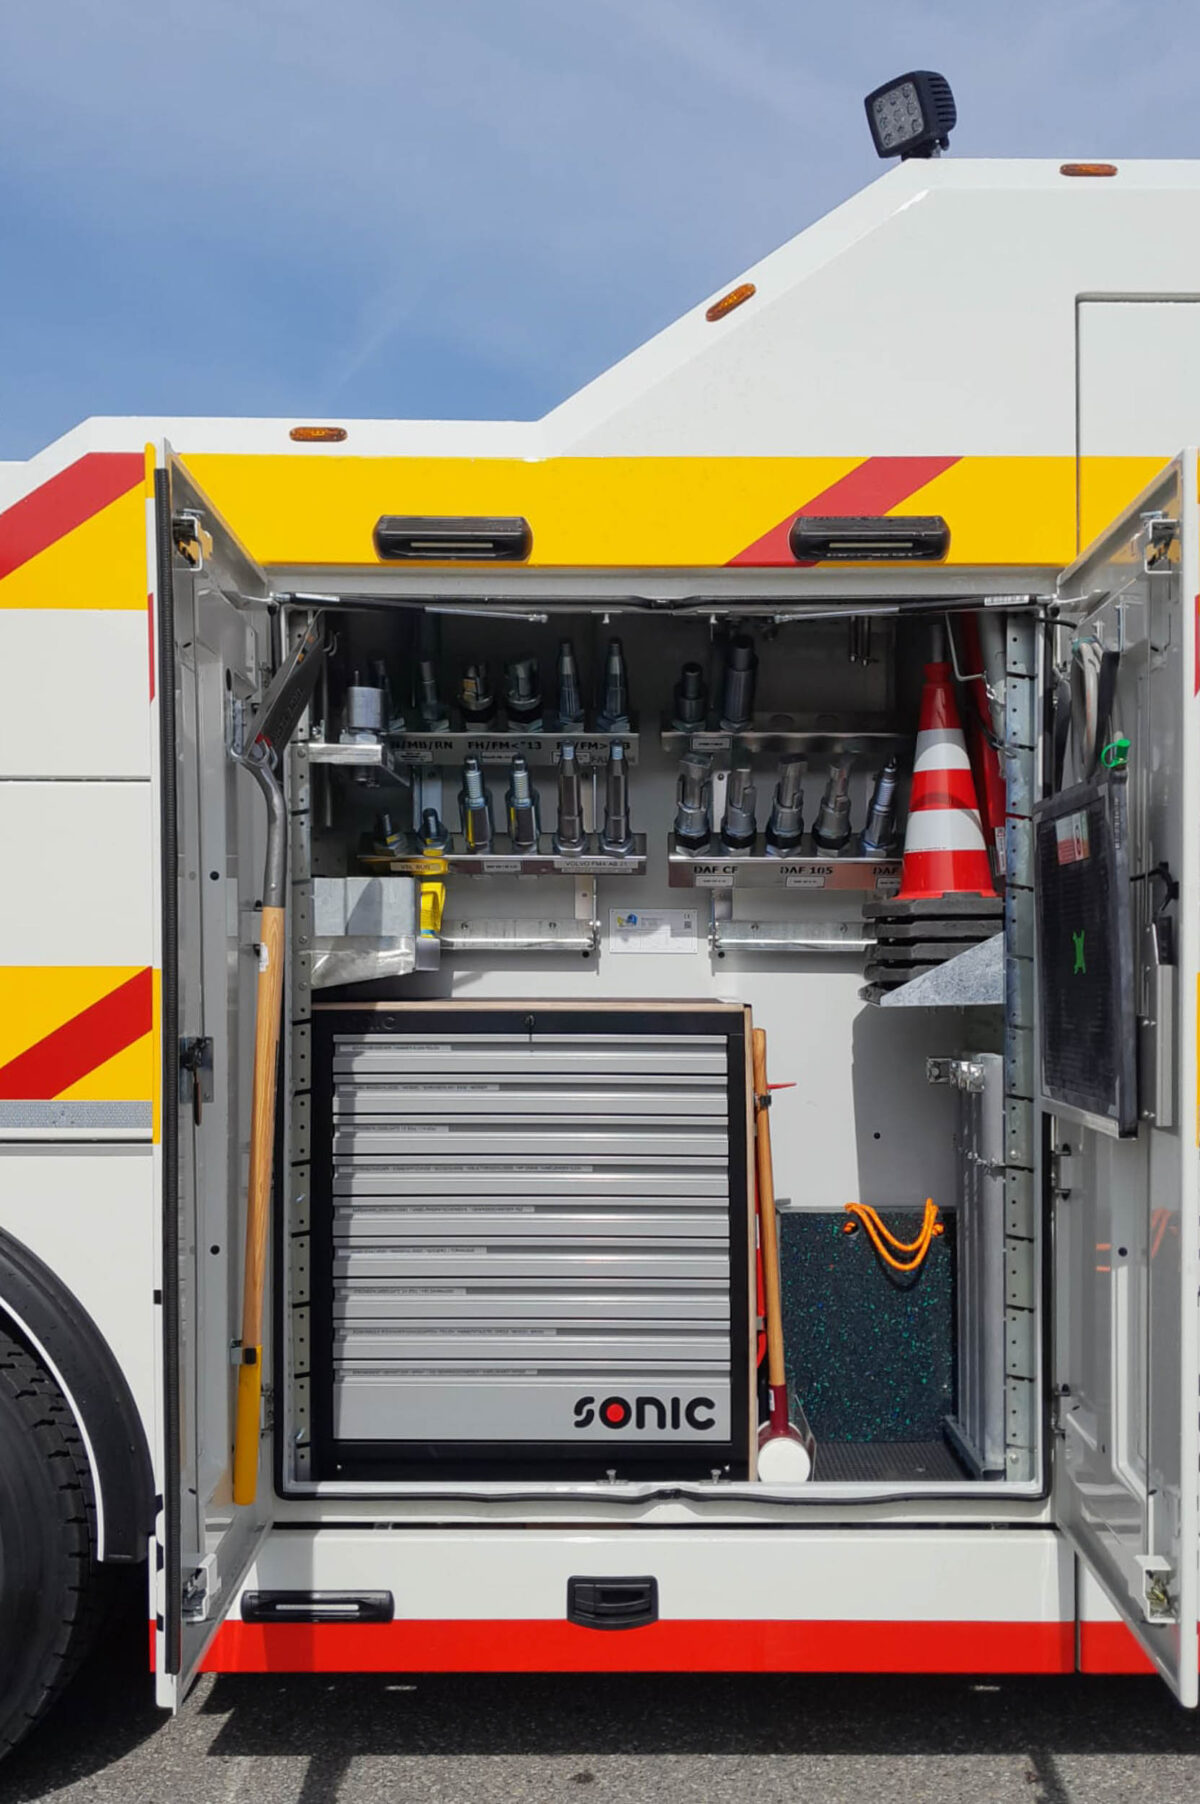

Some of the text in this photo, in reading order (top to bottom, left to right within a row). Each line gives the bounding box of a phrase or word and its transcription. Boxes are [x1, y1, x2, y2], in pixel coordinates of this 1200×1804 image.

[694, 865, 739, 874] DAF CF
[780, 865, 833, 874] DAF 105
[573, 1395, 716, 1431] SONIC
